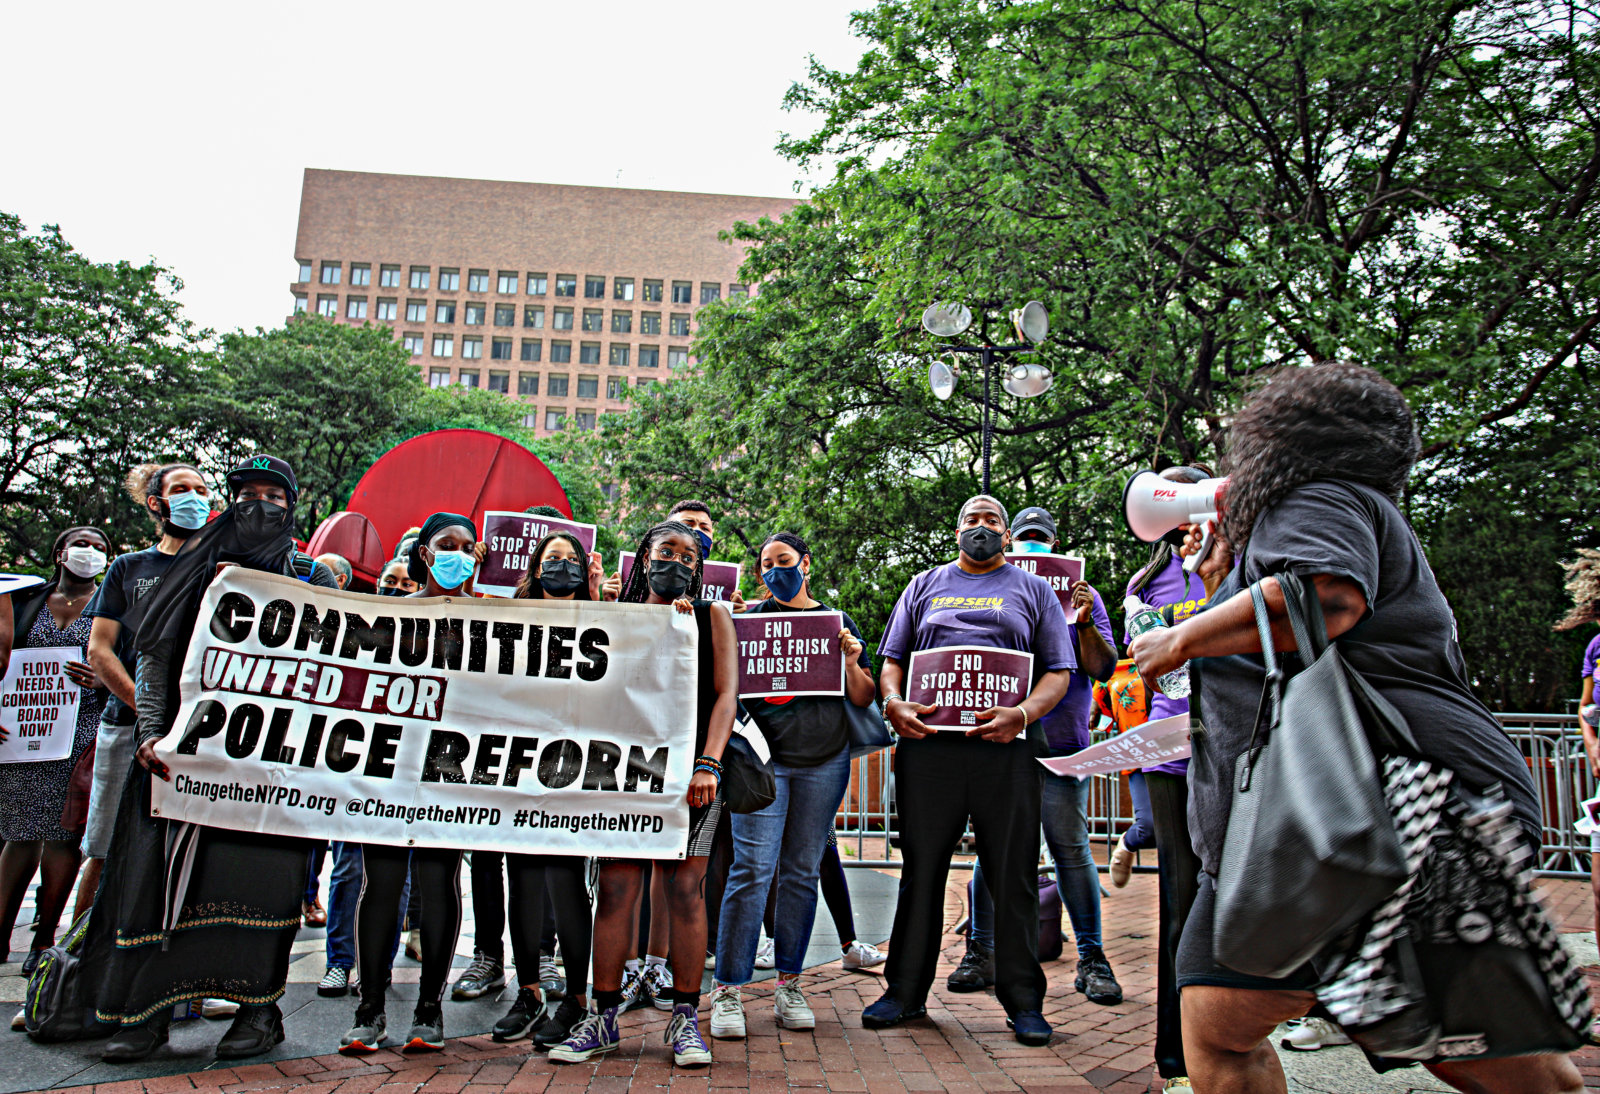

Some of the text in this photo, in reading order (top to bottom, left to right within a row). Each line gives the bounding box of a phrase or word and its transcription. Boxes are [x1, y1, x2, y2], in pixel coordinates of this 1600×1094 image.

[1153, 489, 1178, 498] PYLE
[522, 521, 549, 539] END
[491, 535, 537, 555] STOP &
[503, 553, 530, 571] ABU
[701, 583, 725, 600] ISK
[1041, 575, 1070, 591] ISK
[931, 596, 1004, 606] 1199SEIU
[209, 591, 609, 682] COMMUNITIES
[764, 621, 792, 639] END
[737, 638, 830, 657] TOP & FRISK
[22, 661, 60, 677] FLOYD
[746, 656, 808, 675] ABUSES!
[954, 654, 982, 671] END
[16, 676, 65, 692] NEEDS A
[203, 649, 441, 719] UNITED FOR
[920, 672, 1019, 694] STOP & FRISK
[2, 691, 76, 708] COMMUNITY
[935, 690, 999, 708] ABUSES!
[17, 707, 59, 722] BOARD
[19, 723, 54, 737] NOW!
[177, 699, 669, 794] POLICE REFORM
[175, 774, 664, 834] ChangetheNYPD.org @ChangetheNYPD #ChangetheNYPD
